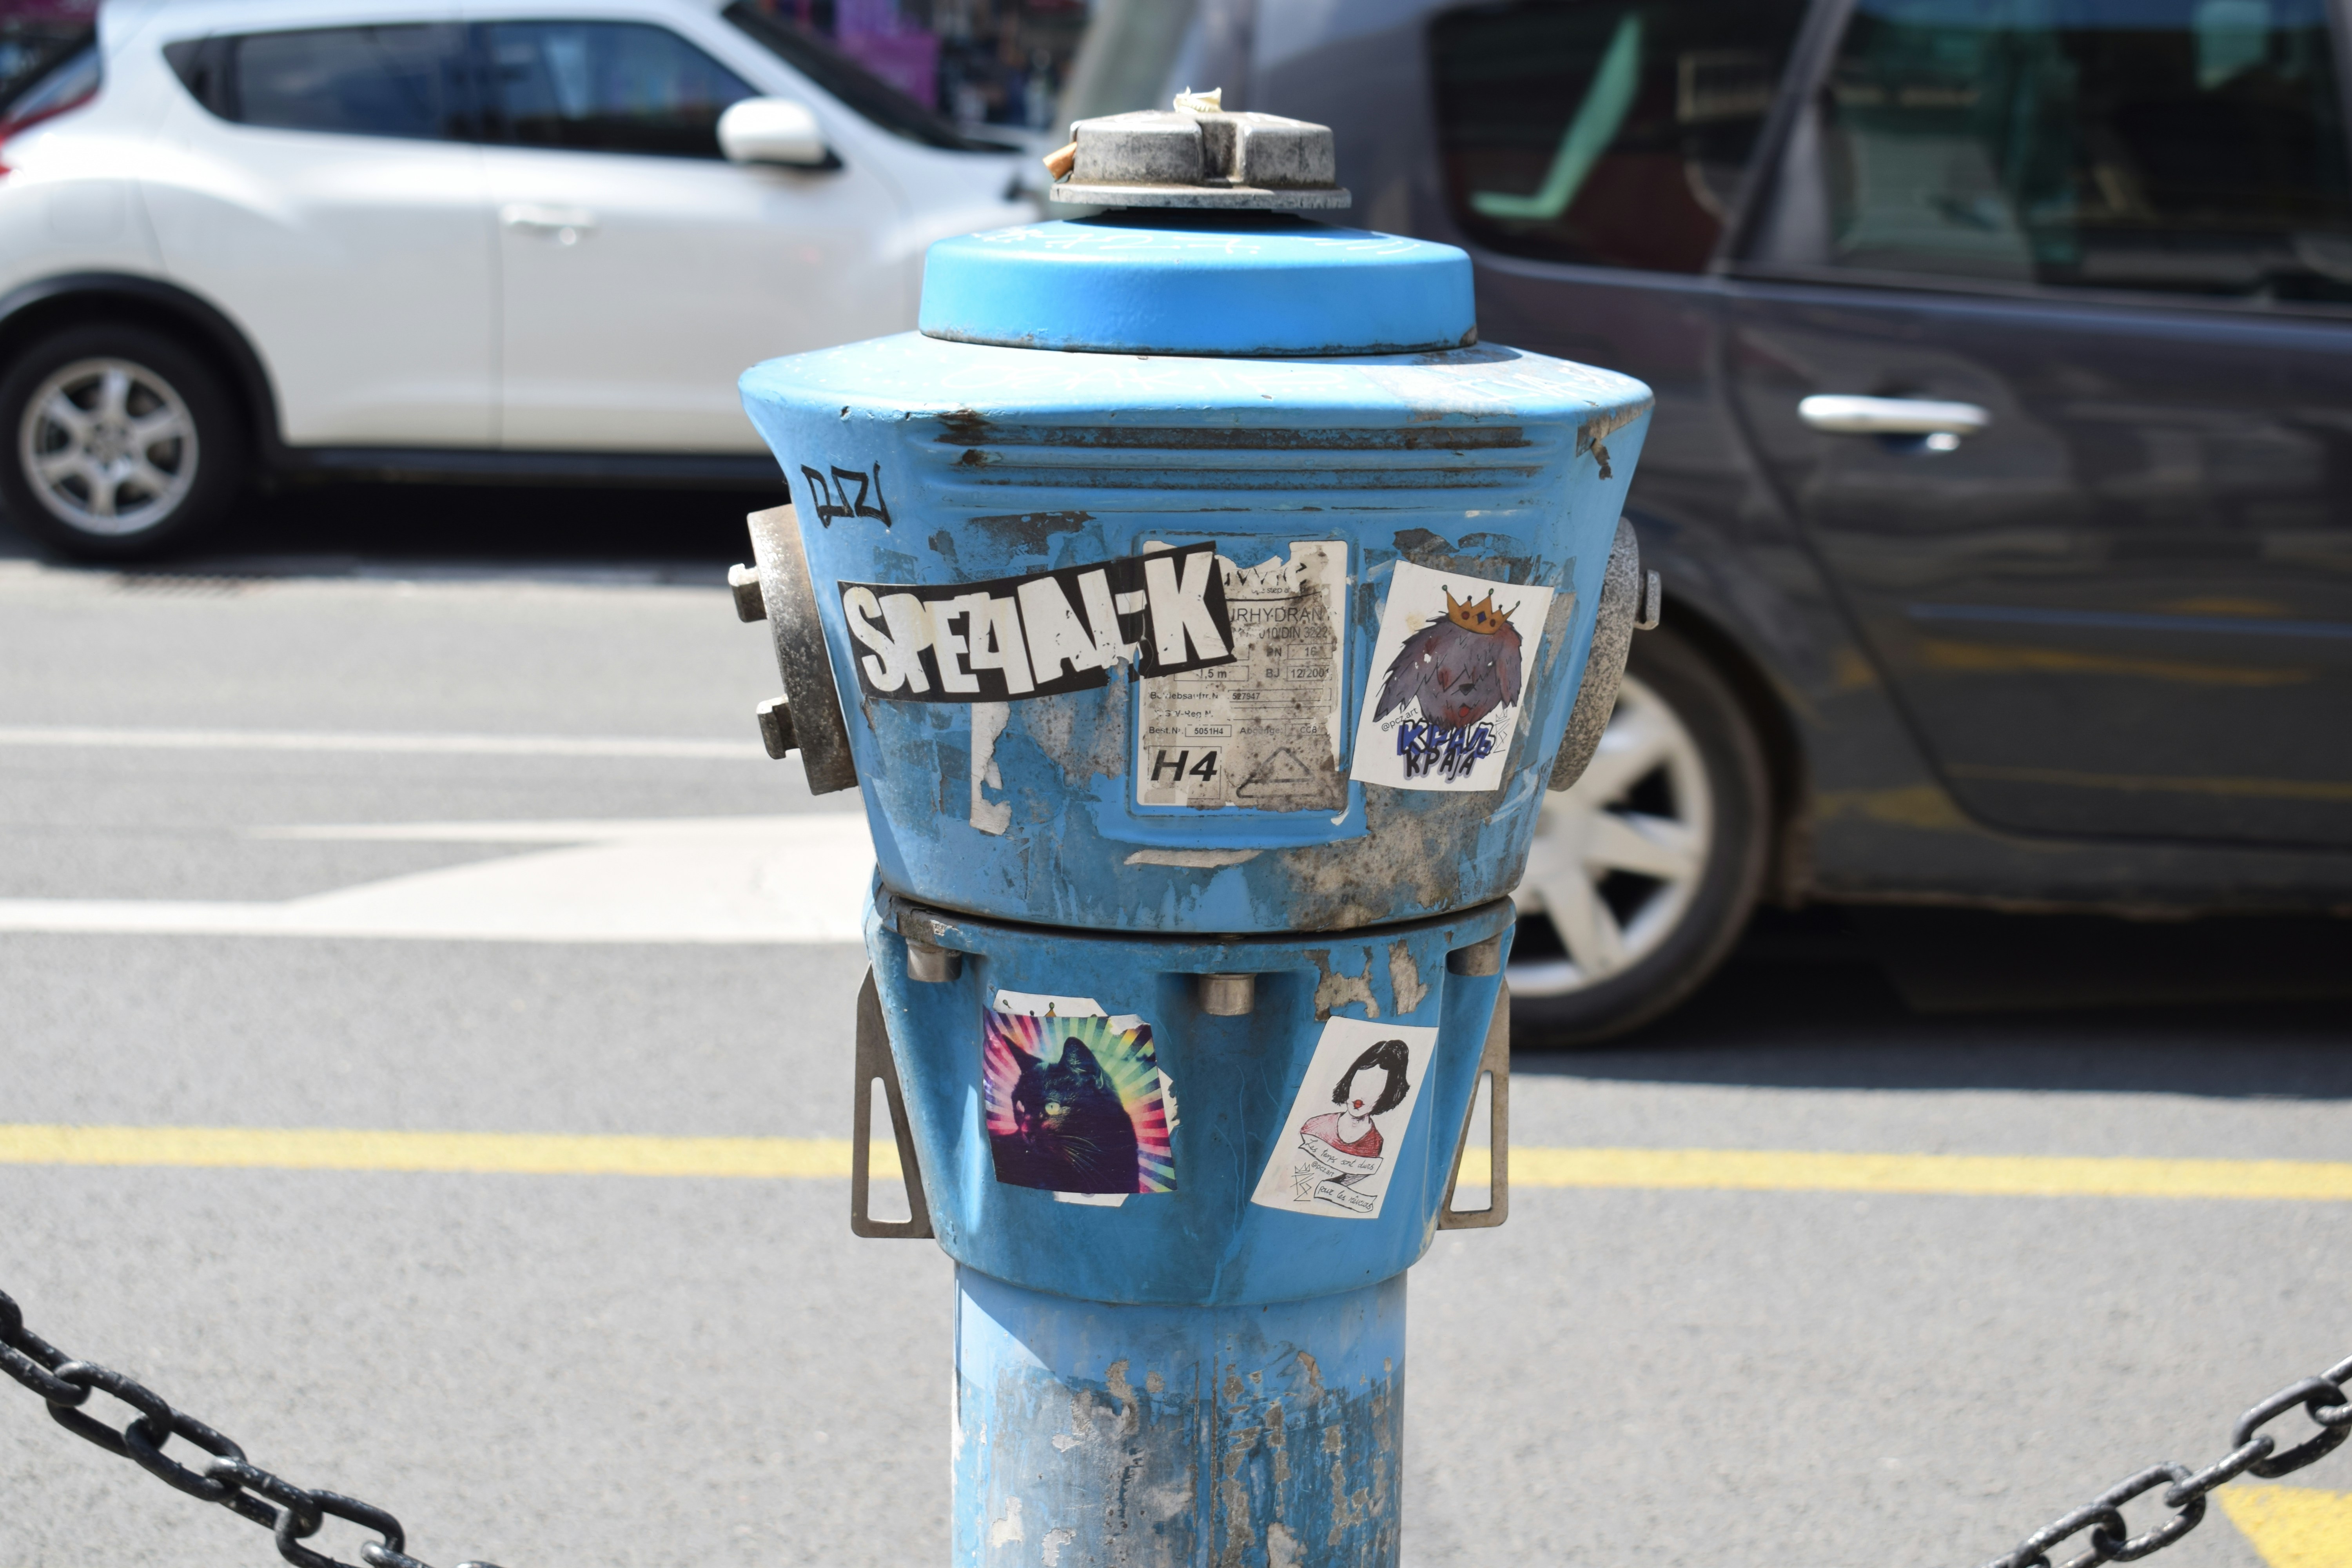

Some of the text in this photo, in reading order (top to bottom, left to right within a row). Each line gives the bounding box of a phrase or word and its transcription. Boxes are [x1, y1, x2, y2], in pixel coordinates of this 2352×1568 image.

[1304, 627, 1328, 638] 3222
[1266, 669, 1280, 678] BJ
[1381, 707, 1419, 732] @pcz.art
[1151, 750, 1217, 781] H4
[1305, 1138, 1375, 1170] Les temps sont durs
[1311, 1161, 1334, 1177] @pcz.art
[1318, 1185, 1334, 1196] pour
[1337, 1190, 1345, 1201] les
